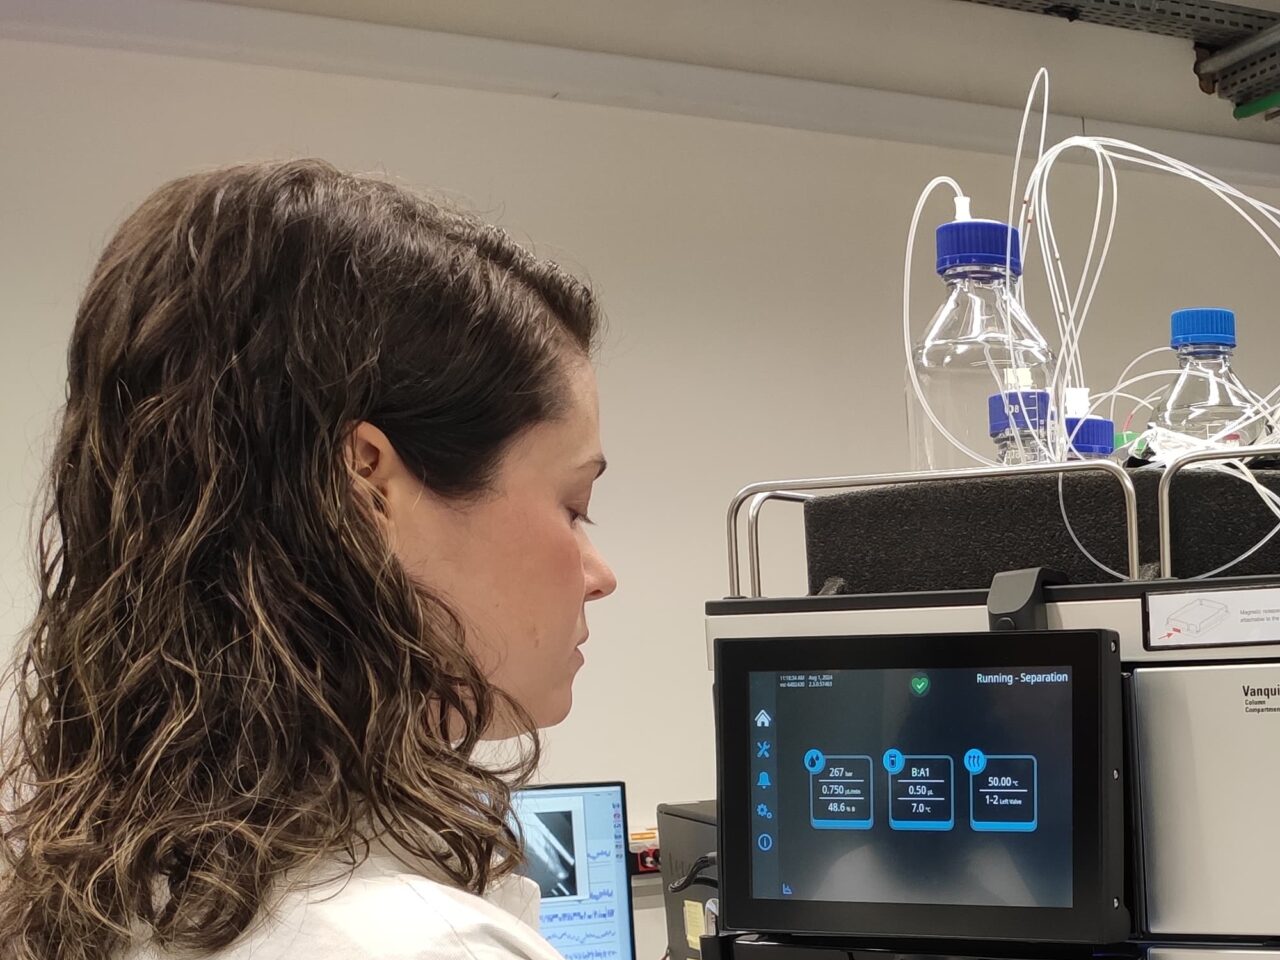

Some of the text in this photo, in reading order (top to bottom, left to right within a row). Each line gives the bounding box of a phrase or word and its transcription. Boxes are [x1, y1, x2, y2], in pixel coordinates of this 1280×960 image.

[976, 673, 1013, 685] Running
[1020, 672, 1069, 685] Separation
[829, 767, 845, 777] 267
[988, 777, 1012, 787] 50.00
[822, 785, 844, 795] 0.750
[908, 785, 927, 795] 0.50
[828, 802, 846, 812] 48.6
[911, 803, 925, 813] 7.0
